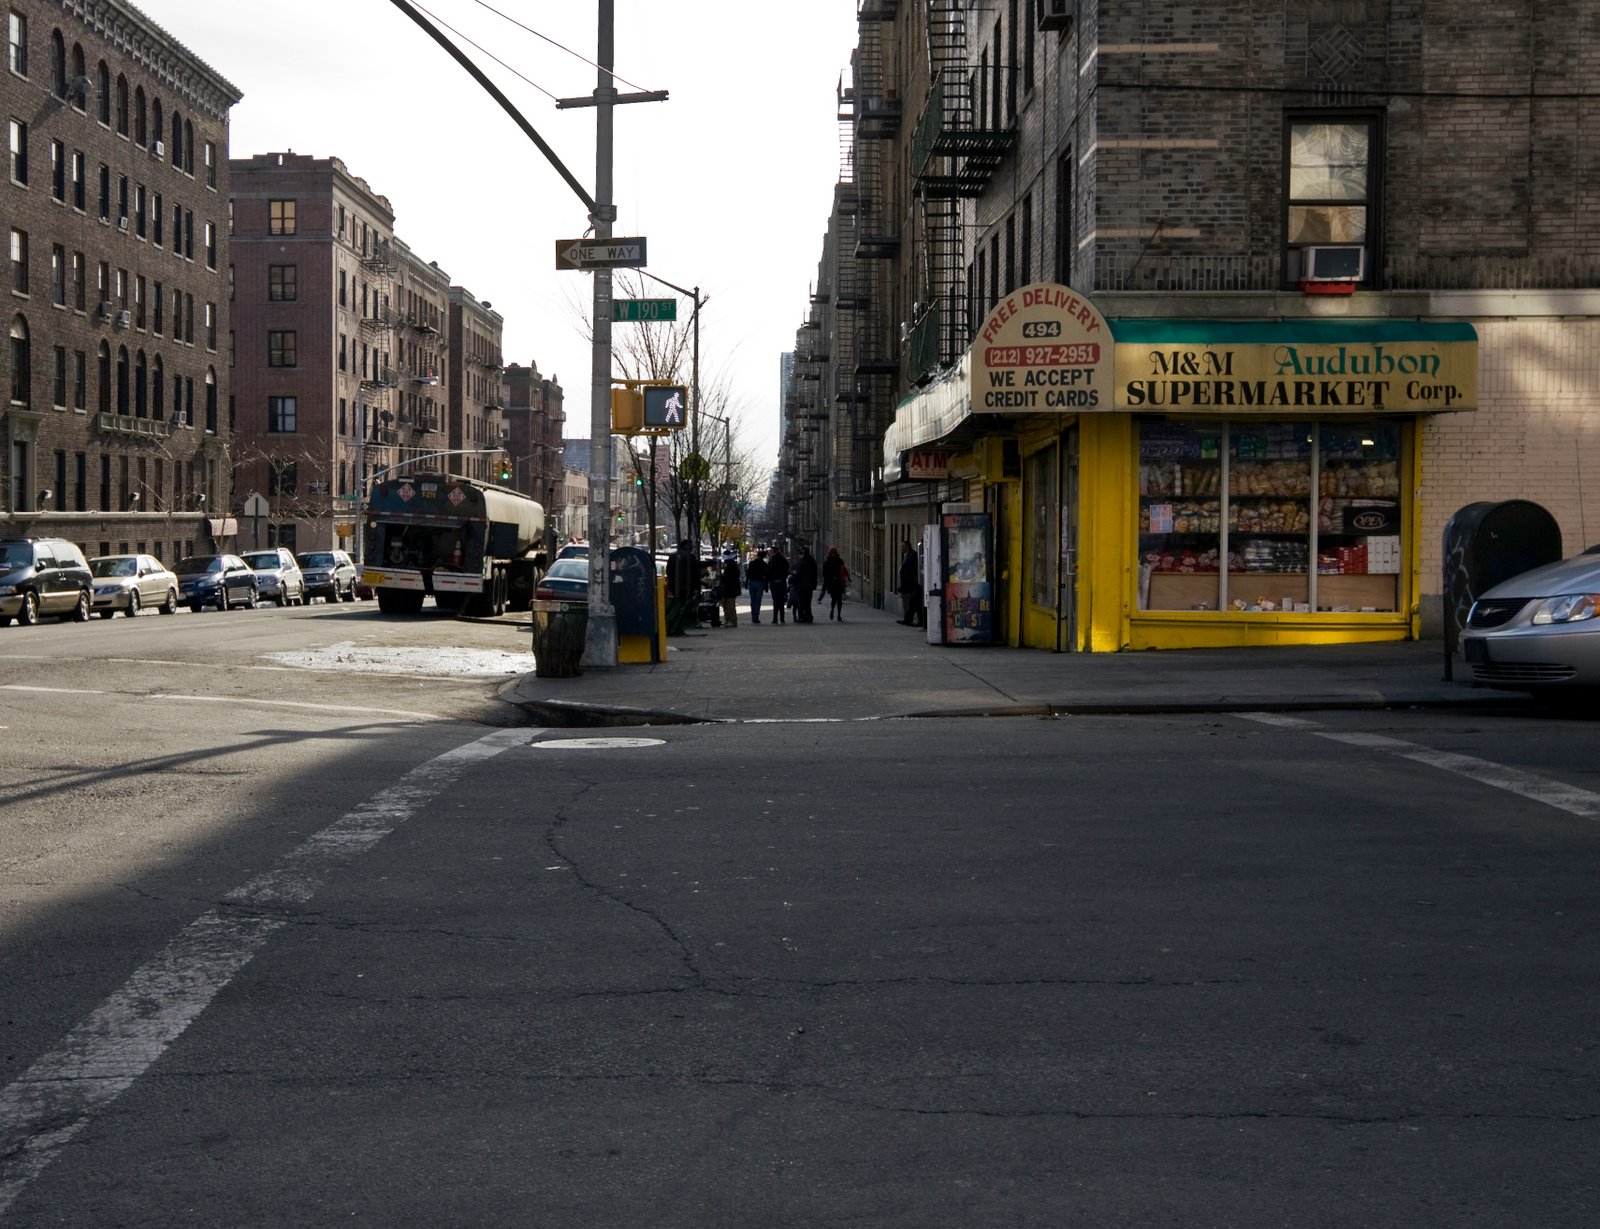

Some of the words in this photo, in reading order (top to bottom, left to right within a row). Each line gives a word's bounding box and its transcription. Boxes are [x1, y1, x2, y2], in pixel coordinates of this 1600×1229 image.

[570, 248, 595, 261] ONE
[607, 246, 635, 259] WAY
[619, 303, 630, 319] W
[637, 302, 659, 319] 190
[662, 302, 674, 311] ST
[982, 298, 1018, 344] FREE
[1022, 288, 1100, 333] DELIVERY
[1025, 322, 1059, 337] 494
[990, 348, 1020, 366] (212)
[1025, 345, 1095, 365] 927-2951
[1149, 351, 1234, 376] M&M
[1273, 345, 1441, 378] Audubon
[989, 370, 1016, 387] WE
[1024, 368, 1095, 386] ACCEPT
[985, 391, 1038, 408] CREDIT
[1045, 389, 1099, 407] CARDS
[1127, 380, 1390, 406] SUPERMARKET
[1406, 381, 1463, 405] Corp.
[911, 451, 947, 469] ATM
[1357, 514, 1384, 527] OPEN
